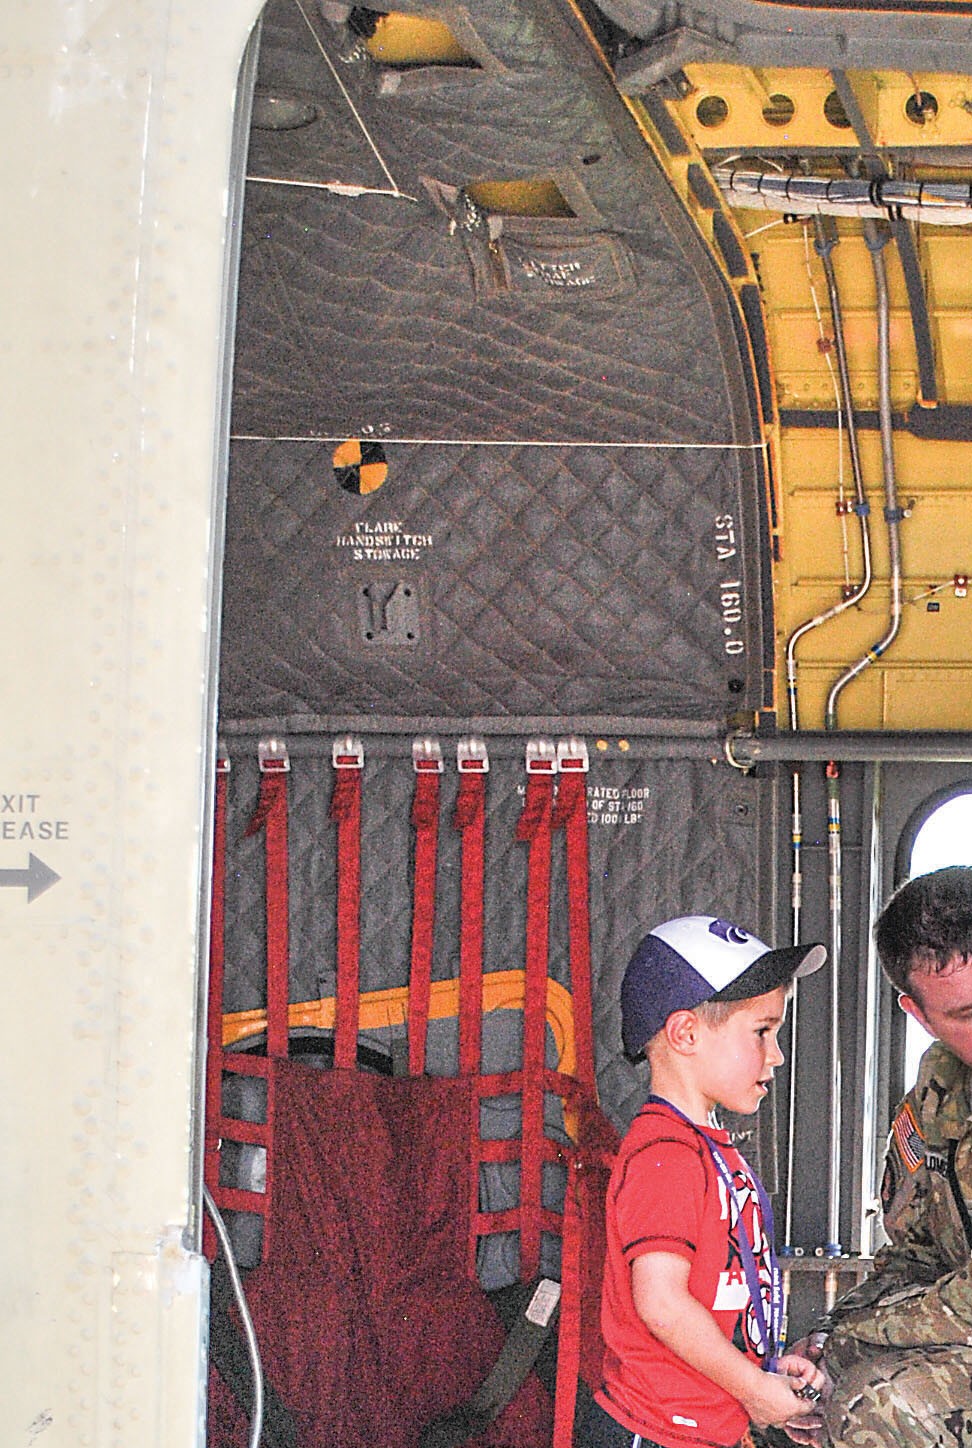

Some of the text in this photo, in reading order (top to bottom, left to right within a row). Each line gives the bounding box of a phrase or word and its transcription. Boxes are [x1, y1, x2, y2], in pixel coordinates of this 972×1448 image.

[354, 522, 403, 533] FLARE
[336, 534, 433, 547] HANDSWITCH
[353, 548, 421, 560] STOWAGE
[715, 514, 744, 655] STA 160.0
